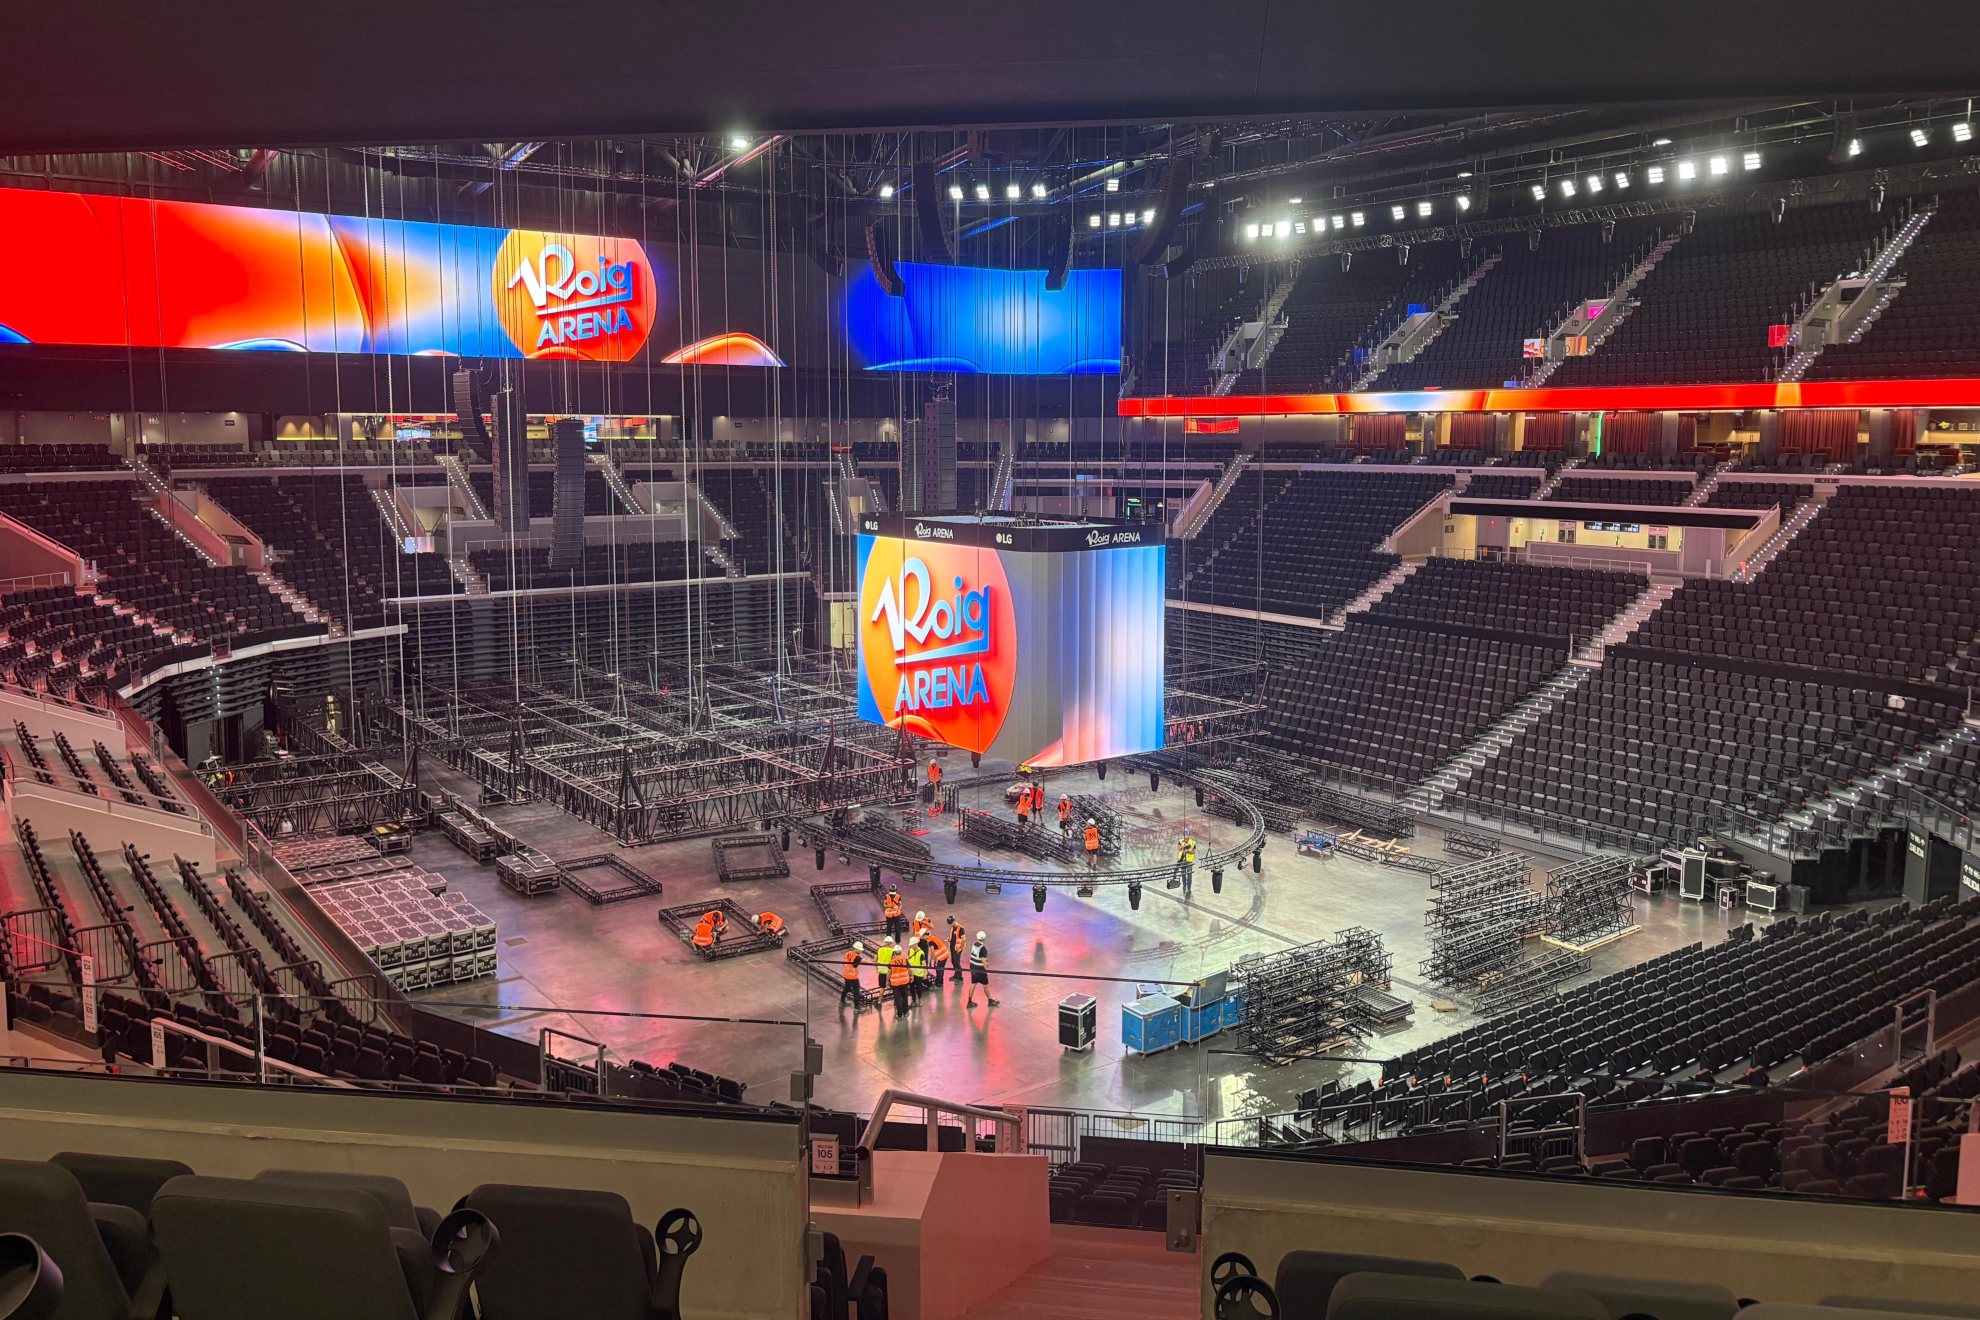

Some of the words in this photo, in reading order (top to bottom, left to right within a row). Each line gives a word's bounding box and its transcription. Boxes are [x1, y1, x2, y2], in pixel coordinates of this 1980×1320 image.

[508, 244, 632, 315] Roig
[537, 307, 632, 346] ARENA
[914, 522, 931, 538] Roig
[932, 527, 953, 539] ARENA
[1085, 530, 1110, 547] Roig
[1111, 532, 1141, 544] ARENA
[872, 556, 990, 664] Roig
[895, 663, 989, 711] ARENA
[817, 1149, 833, 1158] 105
